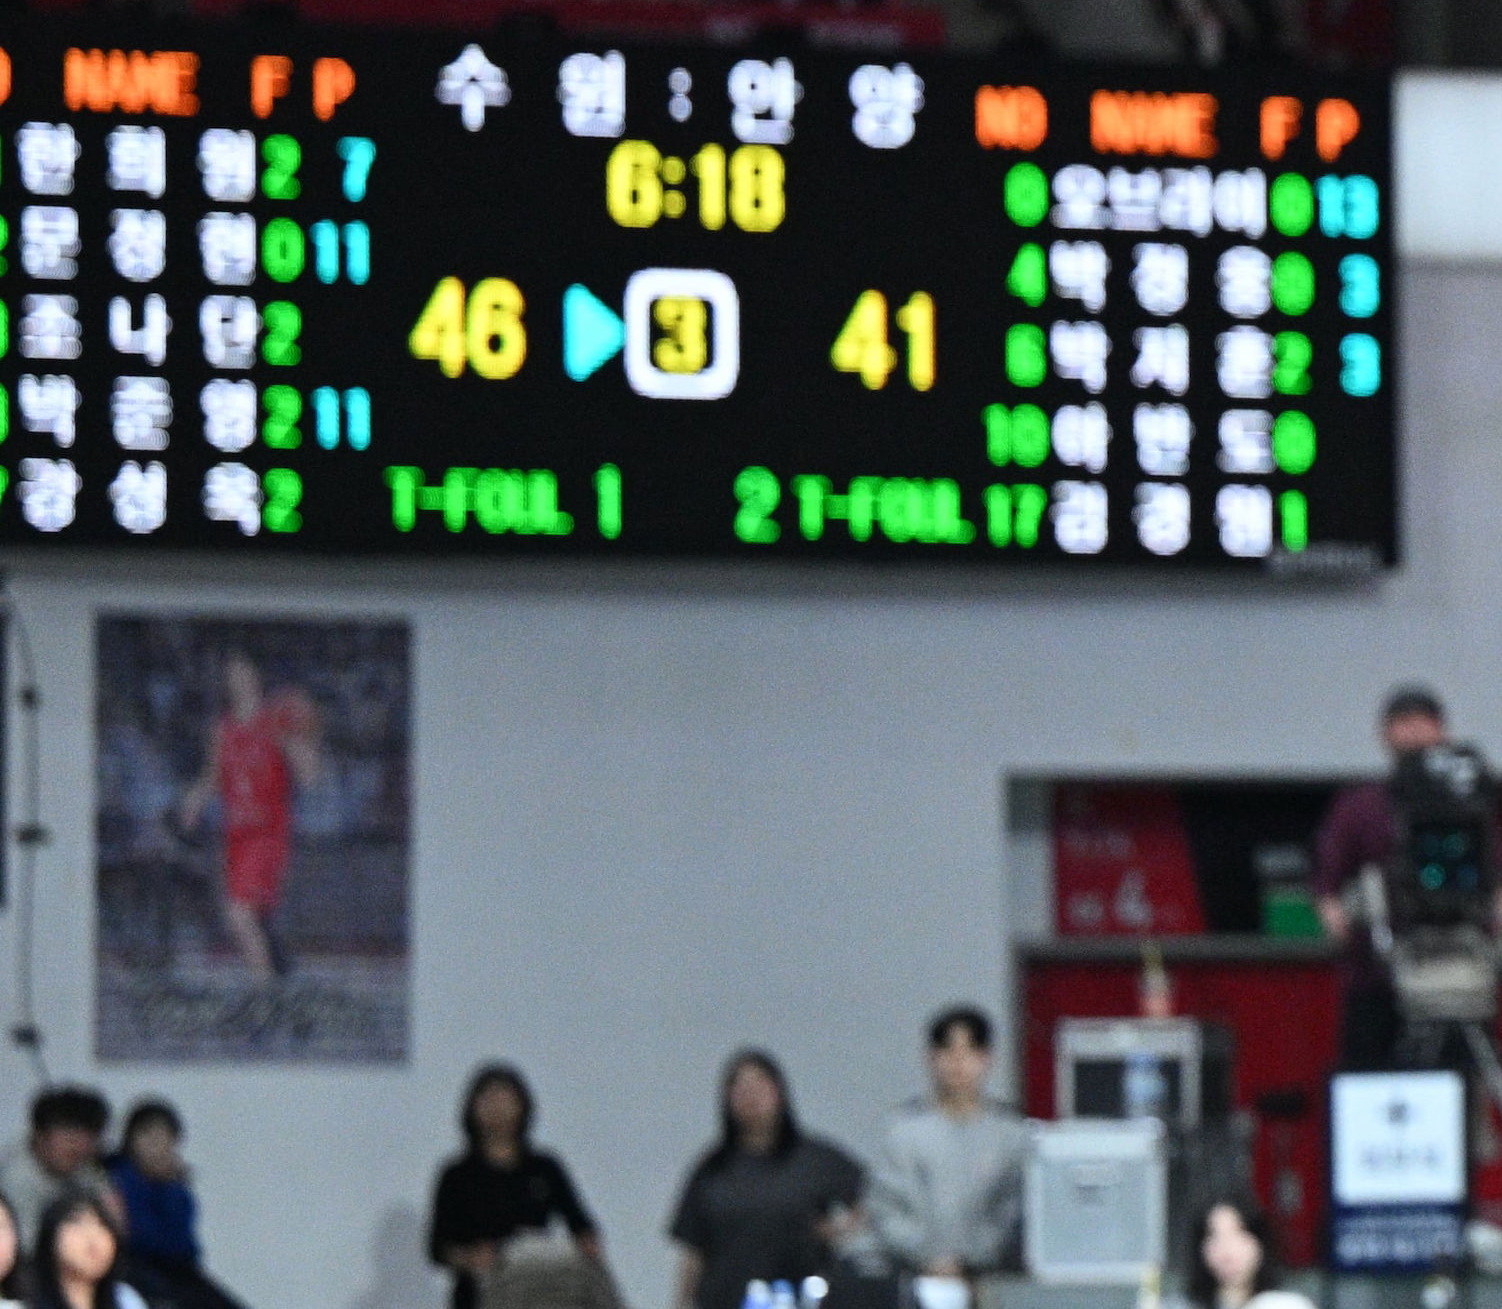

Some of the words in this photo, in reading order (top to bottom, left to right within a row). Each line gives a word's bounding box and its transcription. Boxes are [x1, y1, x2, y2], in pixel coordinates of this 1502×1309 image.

[64, 48, 200, 116] NAME
[251, 55, 293, 118] F
[313, 57, 356, 121] P
[974, 85, 1049, 151] NO
[1089, 89, 1219, 159] NAME
[1259, 96, 1301, 161] F
[1315, 98, 1360, 162] P
[262, 134, 301, 199] 2
[336, 136, 377, 201] 7
[606, 138, 786, 232] 6:18
[261, 217, 305, 283] 0
[311, 219, 371, 285] 11
[1006, 243, 1046, 307] 4
[1339, 253, 1380, 318] 3
[262, 300, 302, 366] 2
[408, 276, 527, 380] 46
[653, 296, 707, 374] 3
[830, 289, 936, 392] 41
[1272, 331, 1312, 396] 2
[1339, 333, 1381, 397] 3
[263, 384, 302, 449] 2
[312, 386, 371, 451] 11
[981, 403, 1051, 468] 10
[263, 467, 302, 533] 2
[384, 465, 575, 536] T-FOUL
[733, 465, 781, 544] 2
[792, 474, 975, 545] T-FOUL
[982, 483, 1047, 548] 17
